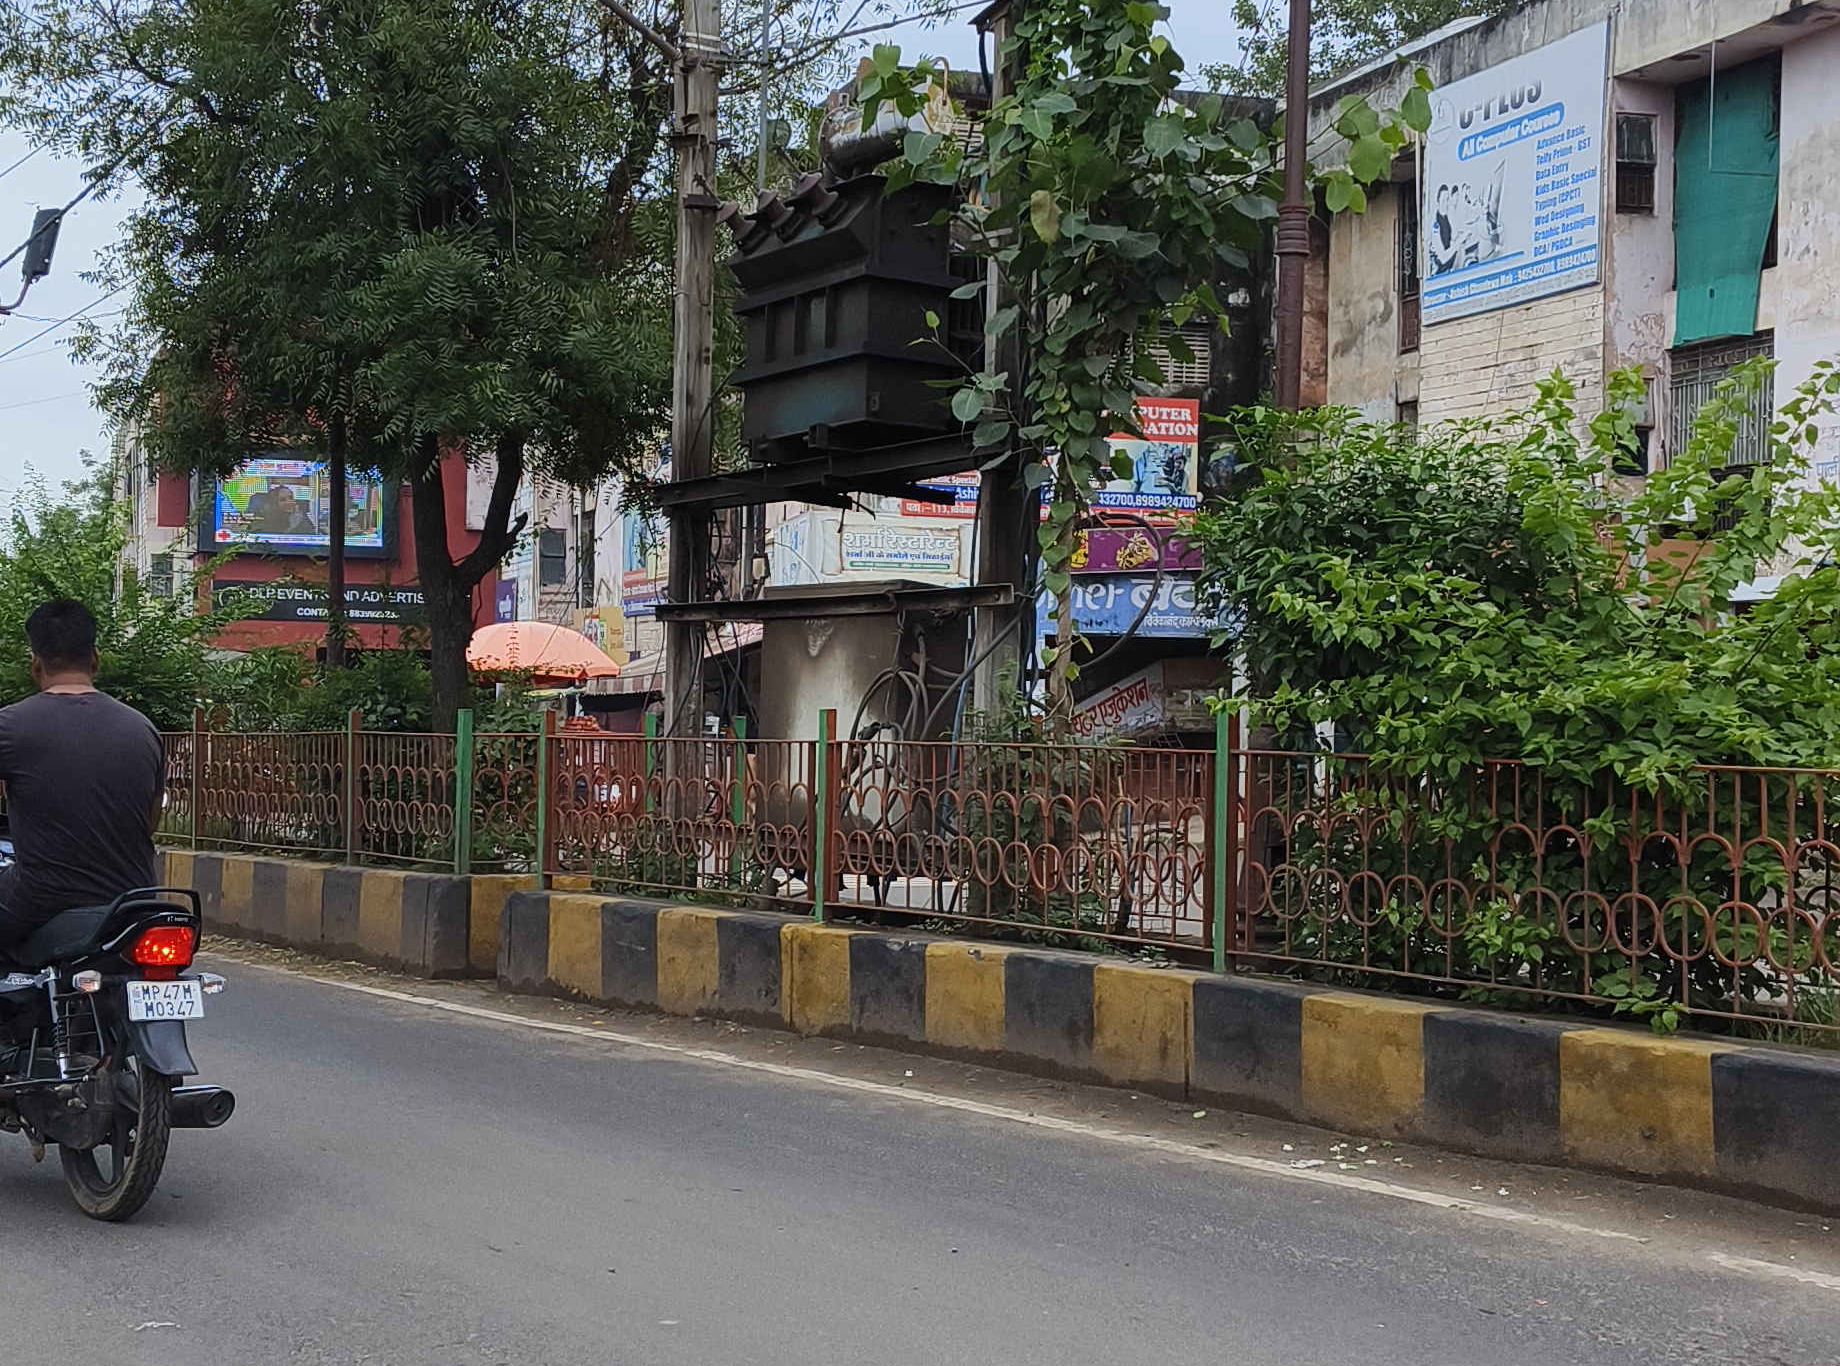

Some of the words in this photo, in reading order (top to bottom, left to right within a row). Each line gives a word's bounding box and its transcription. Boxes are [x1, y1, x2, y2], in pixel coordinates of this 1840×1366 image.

[1566, 125, 1585, 140] Basic
[1577, 137, 1591, 151] GST
[1535, 168, 1550, 181] Data
[1552, 162, 1569, 176] Entry
[1535, 183, 1550, 196] Kids
[1551, 177, 1569, 191] Basic
[1571, 166, 1597, 184] Special
[1139, 406, 1192, 421] PUTER
[1143, 423, 1198, 436] ATION
[843, 525, 885, 549] शर्मा
[145, 1000, 195, 1018] M0347
